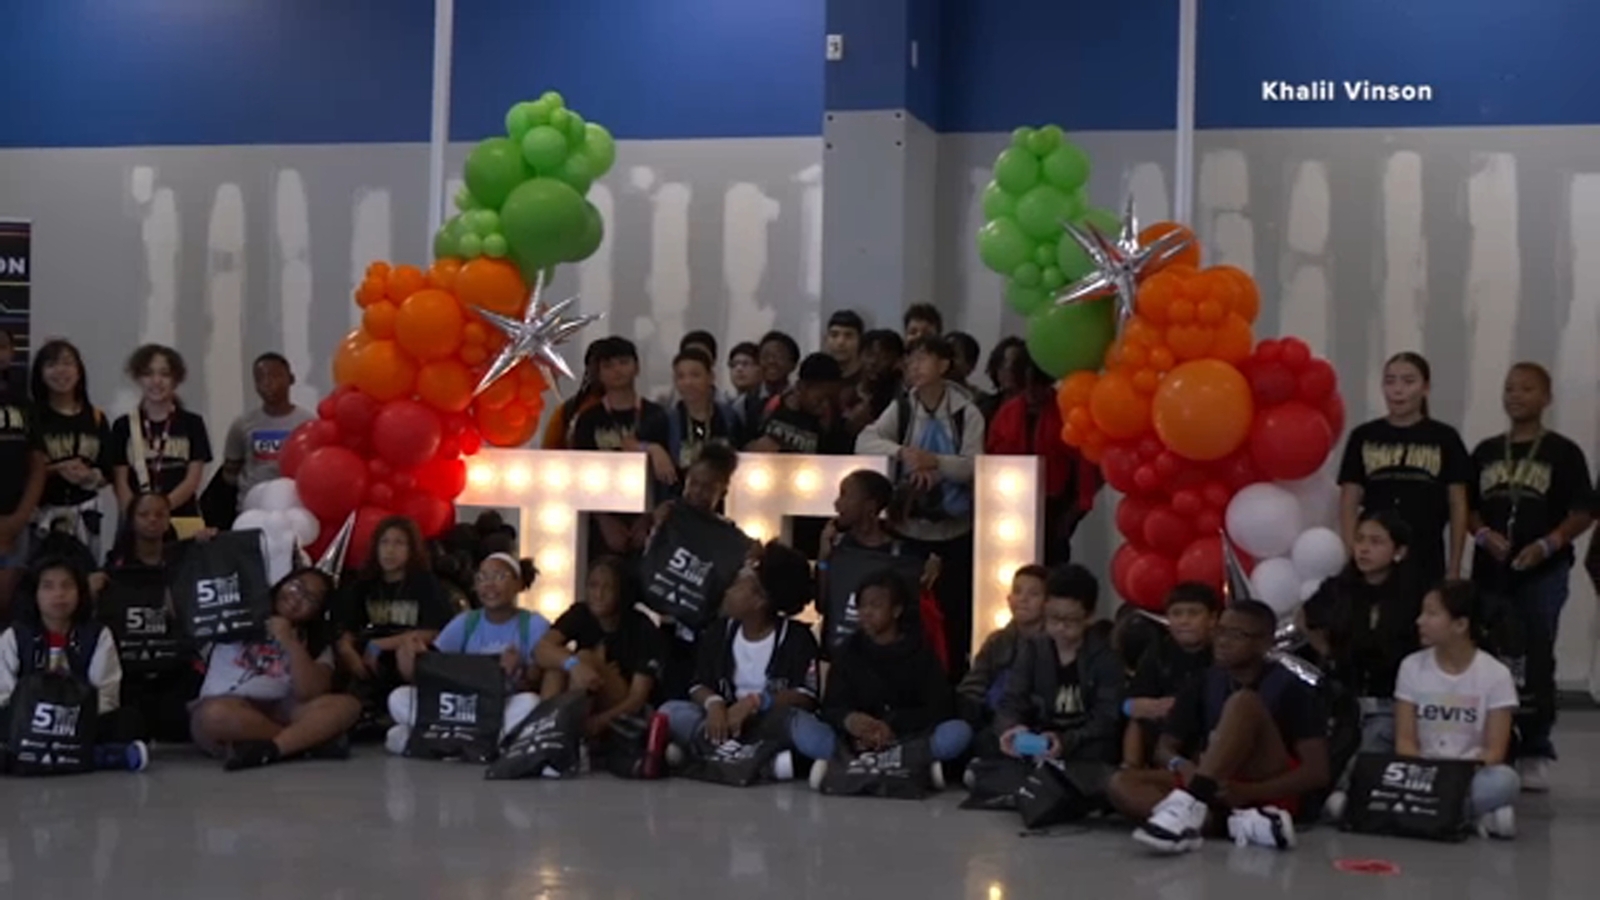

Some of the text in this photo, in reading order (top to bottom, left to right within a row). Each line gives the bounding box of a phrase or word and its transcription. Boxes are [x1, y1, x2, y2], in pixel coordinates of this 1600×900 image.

[669, 547, 692, 570] 5
[197, 579, 216, 603] 5
[126, 606, 144, 629] 5
[439, 691, 455, 715] 5
[32, 702, 54, 728] 5
[1382, 761, 1407, 782] 5
